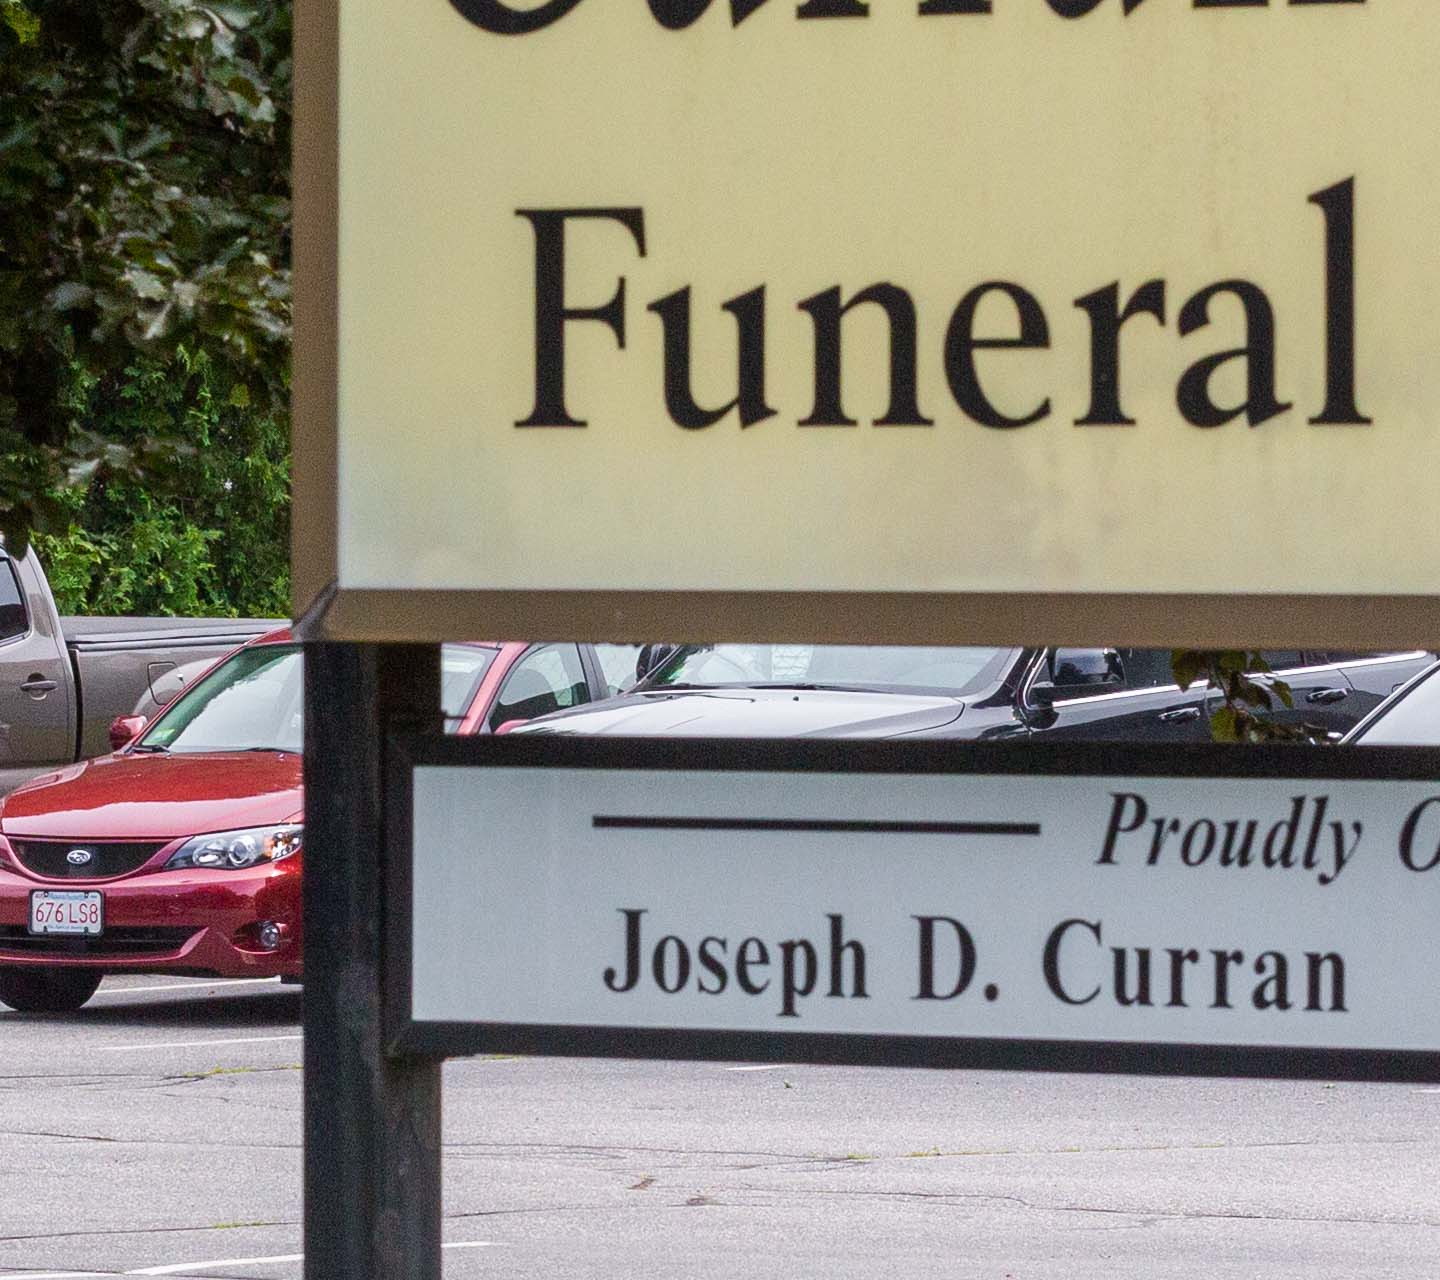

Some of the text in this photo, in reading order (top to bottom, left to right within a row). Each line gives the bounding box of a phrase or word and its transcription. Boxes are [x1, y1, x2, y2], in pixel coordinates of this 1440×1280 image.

[513, 175, 1374, 431] Funeral
[1095, 791, 1363, 886] Proudly
[35, 902, 99, 924] 676 LS8
[602, 907, 1350, 1018] Joseph D. Curran
